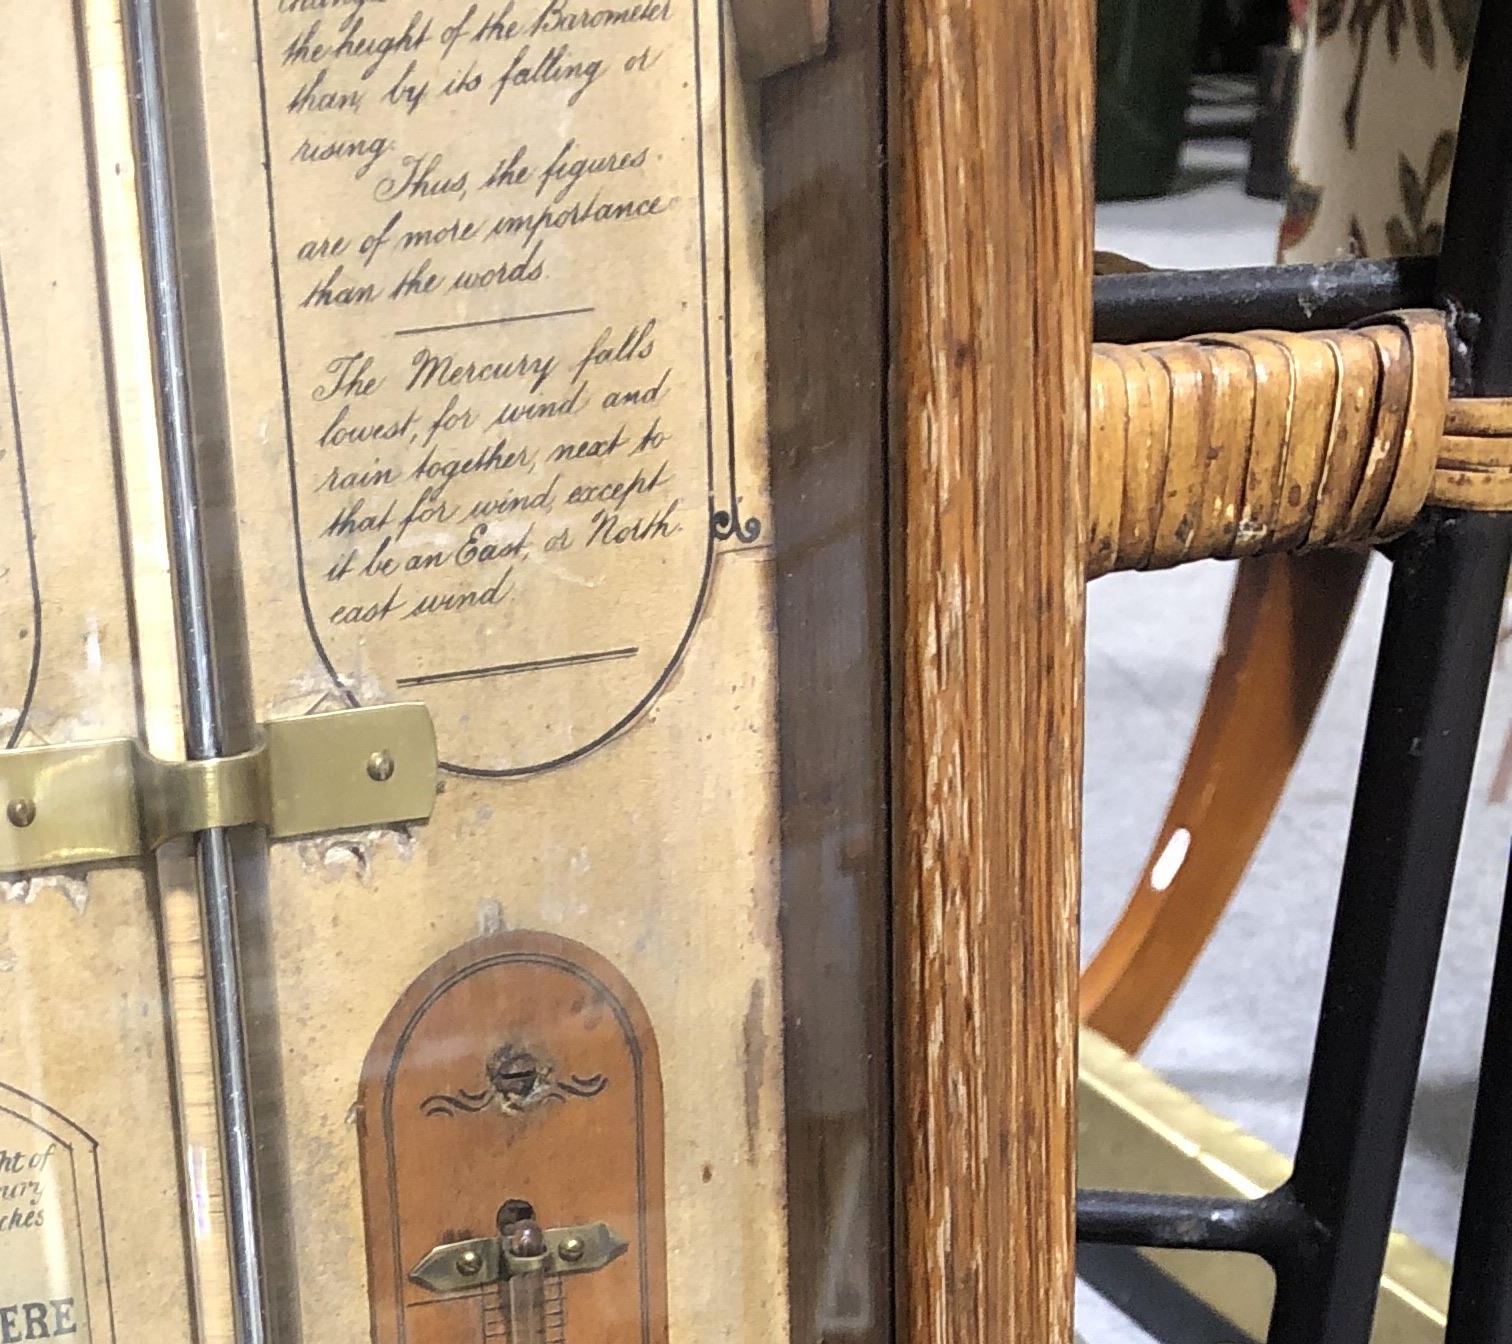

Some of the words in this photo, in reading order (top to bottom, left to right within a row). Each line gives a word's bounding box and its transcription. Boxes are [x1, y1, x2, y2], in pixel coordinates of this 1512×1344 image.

[283, 22, 333, 66] the
[333, 15, 433, 83] height
[440, 4, 468, 60] of
[473, 1, 524, 43] the
[529, 0, 673, 47] Barometer
[384, 61, 429, 115] by
[442, 62, 484, 97] its
[489, 43, 611, 106] falling
[623, 49, 664, 71] or
[374, 153, 470, 202] Thus,
[478, 145, 535, 190] the
[536, 138, 649, 197] figures
[296, 236, 349, 262] are
[359, 210, 402, 264] of
[402, 219, 479, 251] more
[489, 195, 668, 246] importance
[298, 266, 380, 309] than
[389, 256, 445, 299] the
[312, 351, 384, 402] The
[404, 348, 560, 394] Mercury
[575, 318, 656, 377] falls
[317, 404, 419, 450] lowest,
[426, 395, 478, 447] for
[489, 383, 590, 429] wind
[602, 368, 672, 408] and
[315, 458, 404, 493] rain
[409, 434, 539, 498] together,
[546, 425, 630, 463] next
[637, 419, 672, 454] to
[319, 495, 394, 539] that
[397, 484, 458, 541] for
[566, 462, 672, 505] except
[324, 553, 354, 582] it
[359, 536, 404, 577] be
[404, 549, 451, 572] an
[454, 524, 532, 567] East,
[543, 528, 575, 552] or
[329, 583, 404, 625] east
[29, 1143, 56, 1171] of
